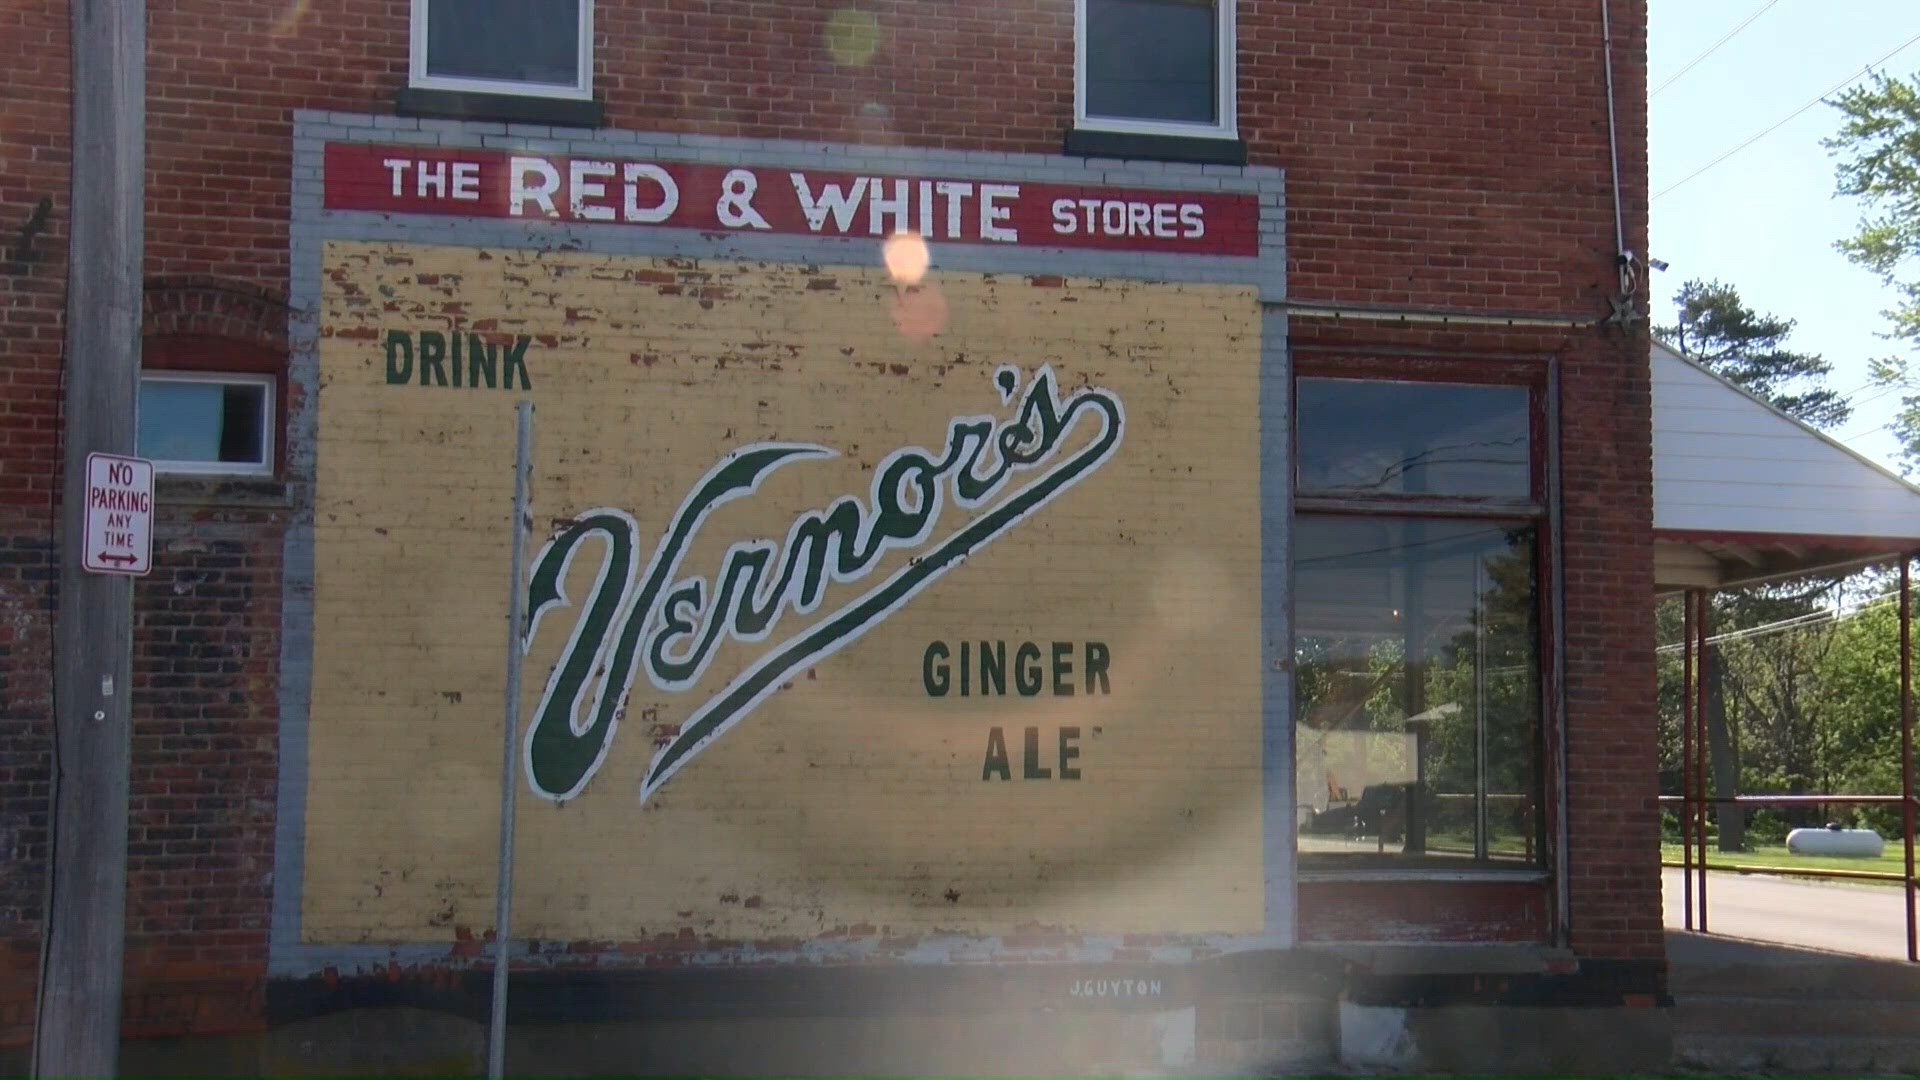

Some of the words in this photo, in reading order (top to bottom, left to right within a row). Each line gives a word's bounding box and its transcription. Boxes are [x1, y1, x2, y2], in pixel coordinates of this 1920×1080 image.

[384, 158, 480, 200] THE
[510, 156, 679, 223] RED
[717, 169, 772, 230] &
[789, 172, 1020, 242] WHITE
[1052, 198, 1205, 239] STORES
[386, 329, 532, 391] DRINK
[91, 487, 148, 513] PARKING
[108, 463, 133, 486] NO
[104, 531, 134, 548] TIME
[107, 512, 131, 528] ANY
[524, 362, 1125, 804] Vernor's
[923, 640, 1111, 697] GINGER
[982, 726, 1081, 781] ALE
